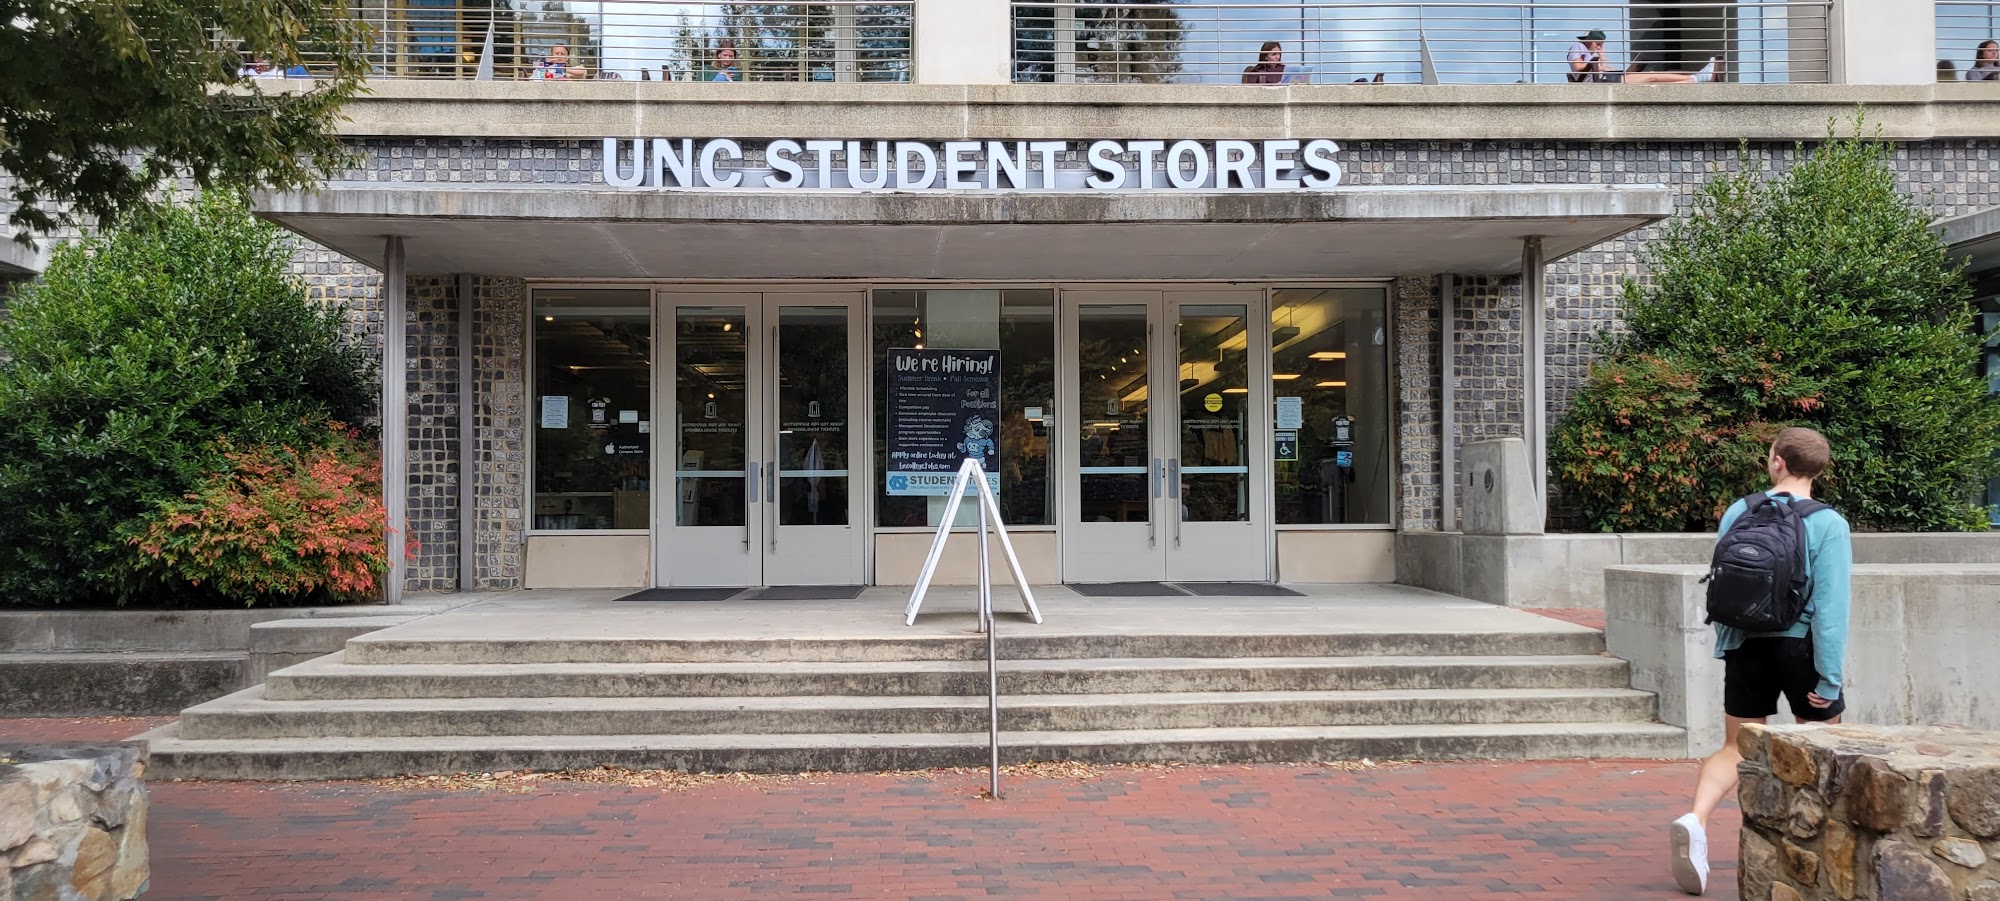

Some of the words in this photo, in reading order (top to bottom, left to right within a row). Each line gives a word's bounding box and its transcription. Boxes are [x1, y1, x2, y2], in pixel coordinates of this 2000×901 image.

[602, 138, 744, 188] UNC
[763, 139, 1067, 189] STUDENT
[1085, 139, 1343, 189] STORES
[896, 353, 939, 372] We're
[942, 355, 994, 374] Hiring!
[910, 451, 927, 459] online
[929, 451, 947, 459] today
